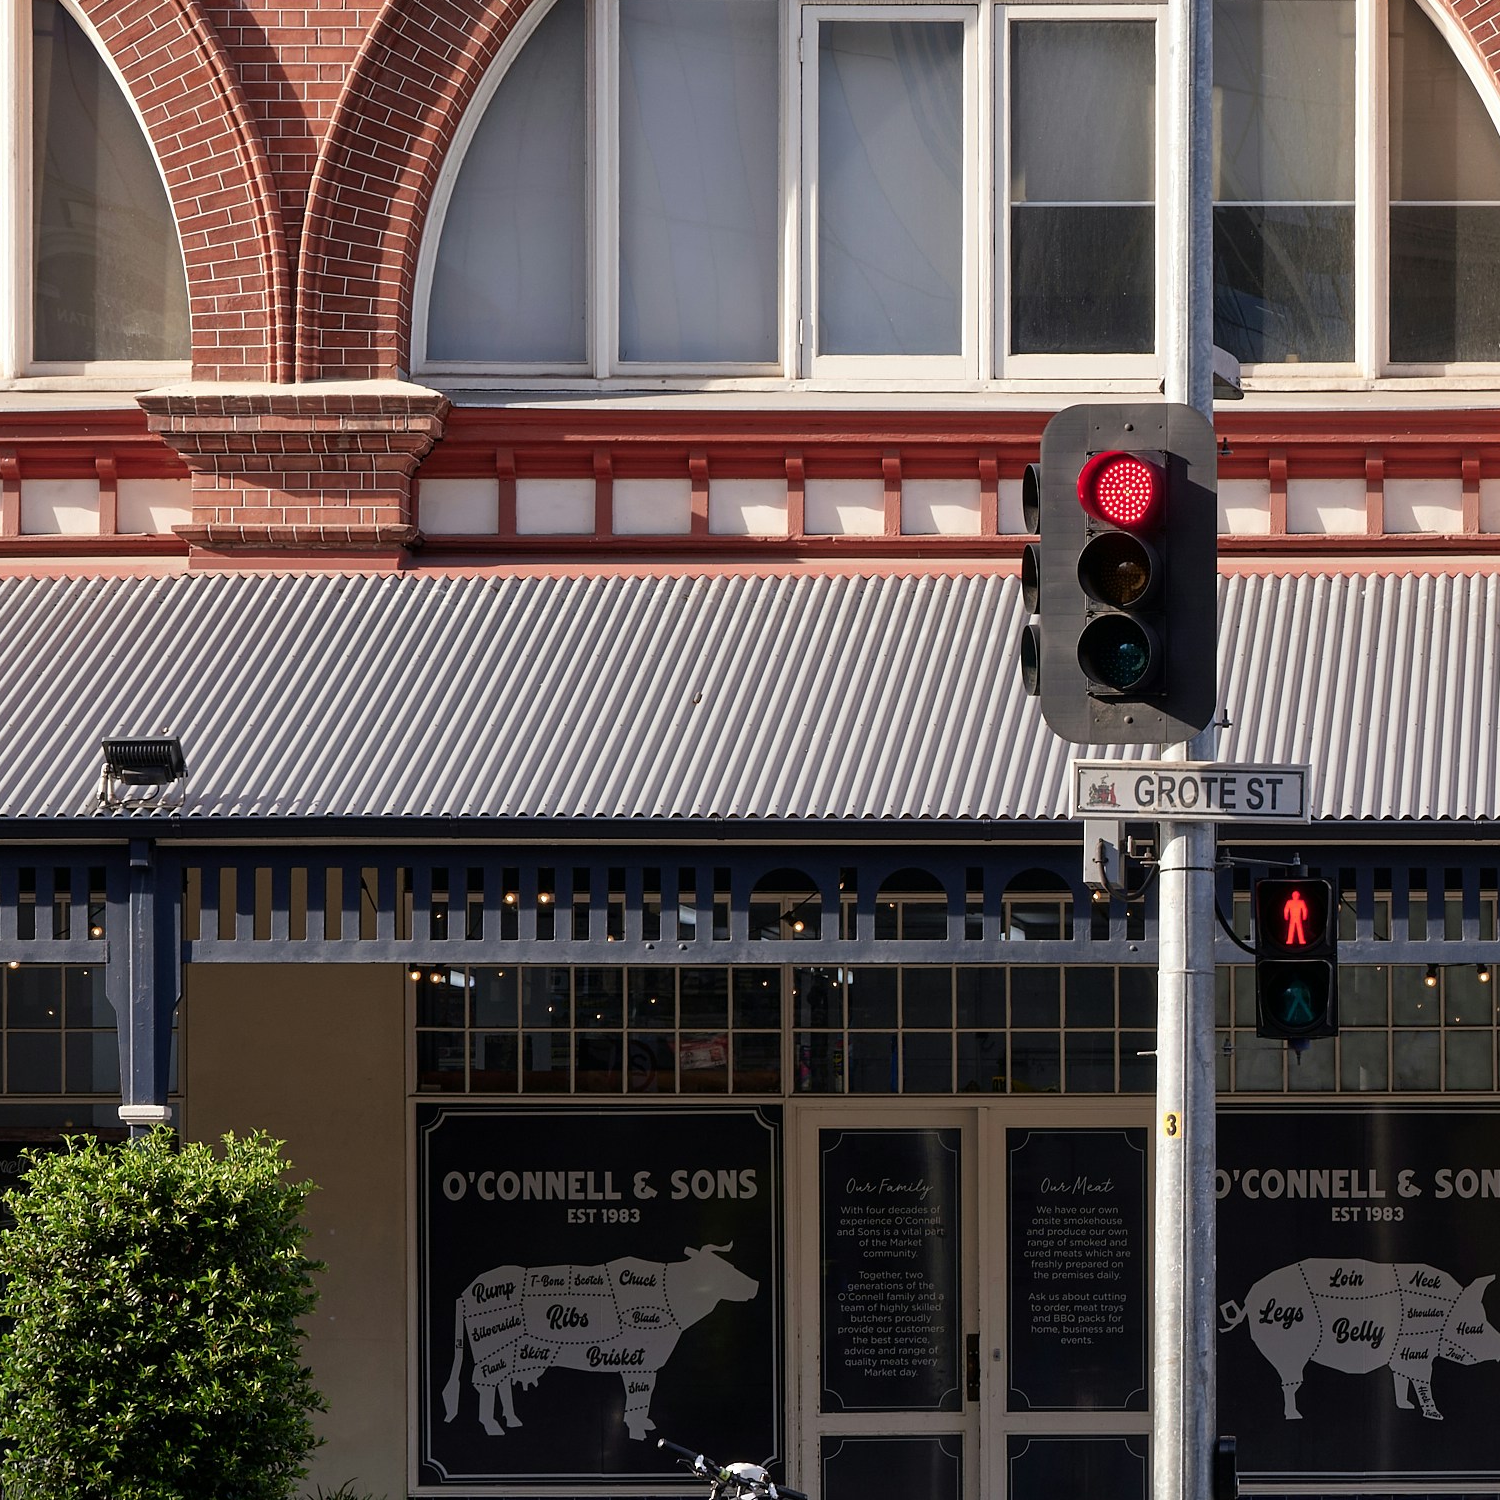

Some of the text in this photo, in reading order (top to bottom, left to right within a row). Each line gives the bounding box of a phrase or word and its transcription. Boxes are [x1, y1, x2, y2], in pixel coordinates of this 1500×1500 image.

[1134, 775, 1283, 810] GROTE ST
[1167, 1114, 1177, 1136] 3
[443, 1169, 758, 1201] O'CONNELL & SONS
[846, 1177, 933, 1200] Our Family
[1041, 1176, 1114, 1195] Our Meat
[1397, 1169, 1422, 1198] &
[568, 1208, 640, 1223] EST 1983
[1036, 1206, 1052, 1214] We
[1055, 1206, 1077, 1214] have
[1332, 1207, 1404, 1222] EST 1983
[840, 1217, 891, 1226] experience
[1032, 1217, 1123, 1225] onsite smokehouse
[925, 1228, 944, 1237] part
[531, 1275, 565, 1287] T-Bone
[574, 1274, 604, 1286] Scotch
[619, 1270, 657, 1287] Chuck
[1329, 1268, 1364, 1288] Loin
[1409, 1270, 1441, 1289] Neck
[471, 1279, 516, 1304] Rump
[546, 1304, 589, 1330] Ribs
[632, 1311, 660, 1323] Blade
[1259, 1298, 1304, 1330] Legs
[1407, 1308, 1444, 1319] Shoulder
[472, 1315, 522, 1343] Silverside
[1332, 1317, 1385, 1349] Belly
[1456, 1322, 1484, 1335] Head
[520, 1344, 550, 1360] Skirt
[586, 1346, 645, 1367] Brisket
[1400, 1347, 1428, 1361] Hand
[480, 1357, 507, 1379] Flank
[628, 1381, 650, 1394] Shin
